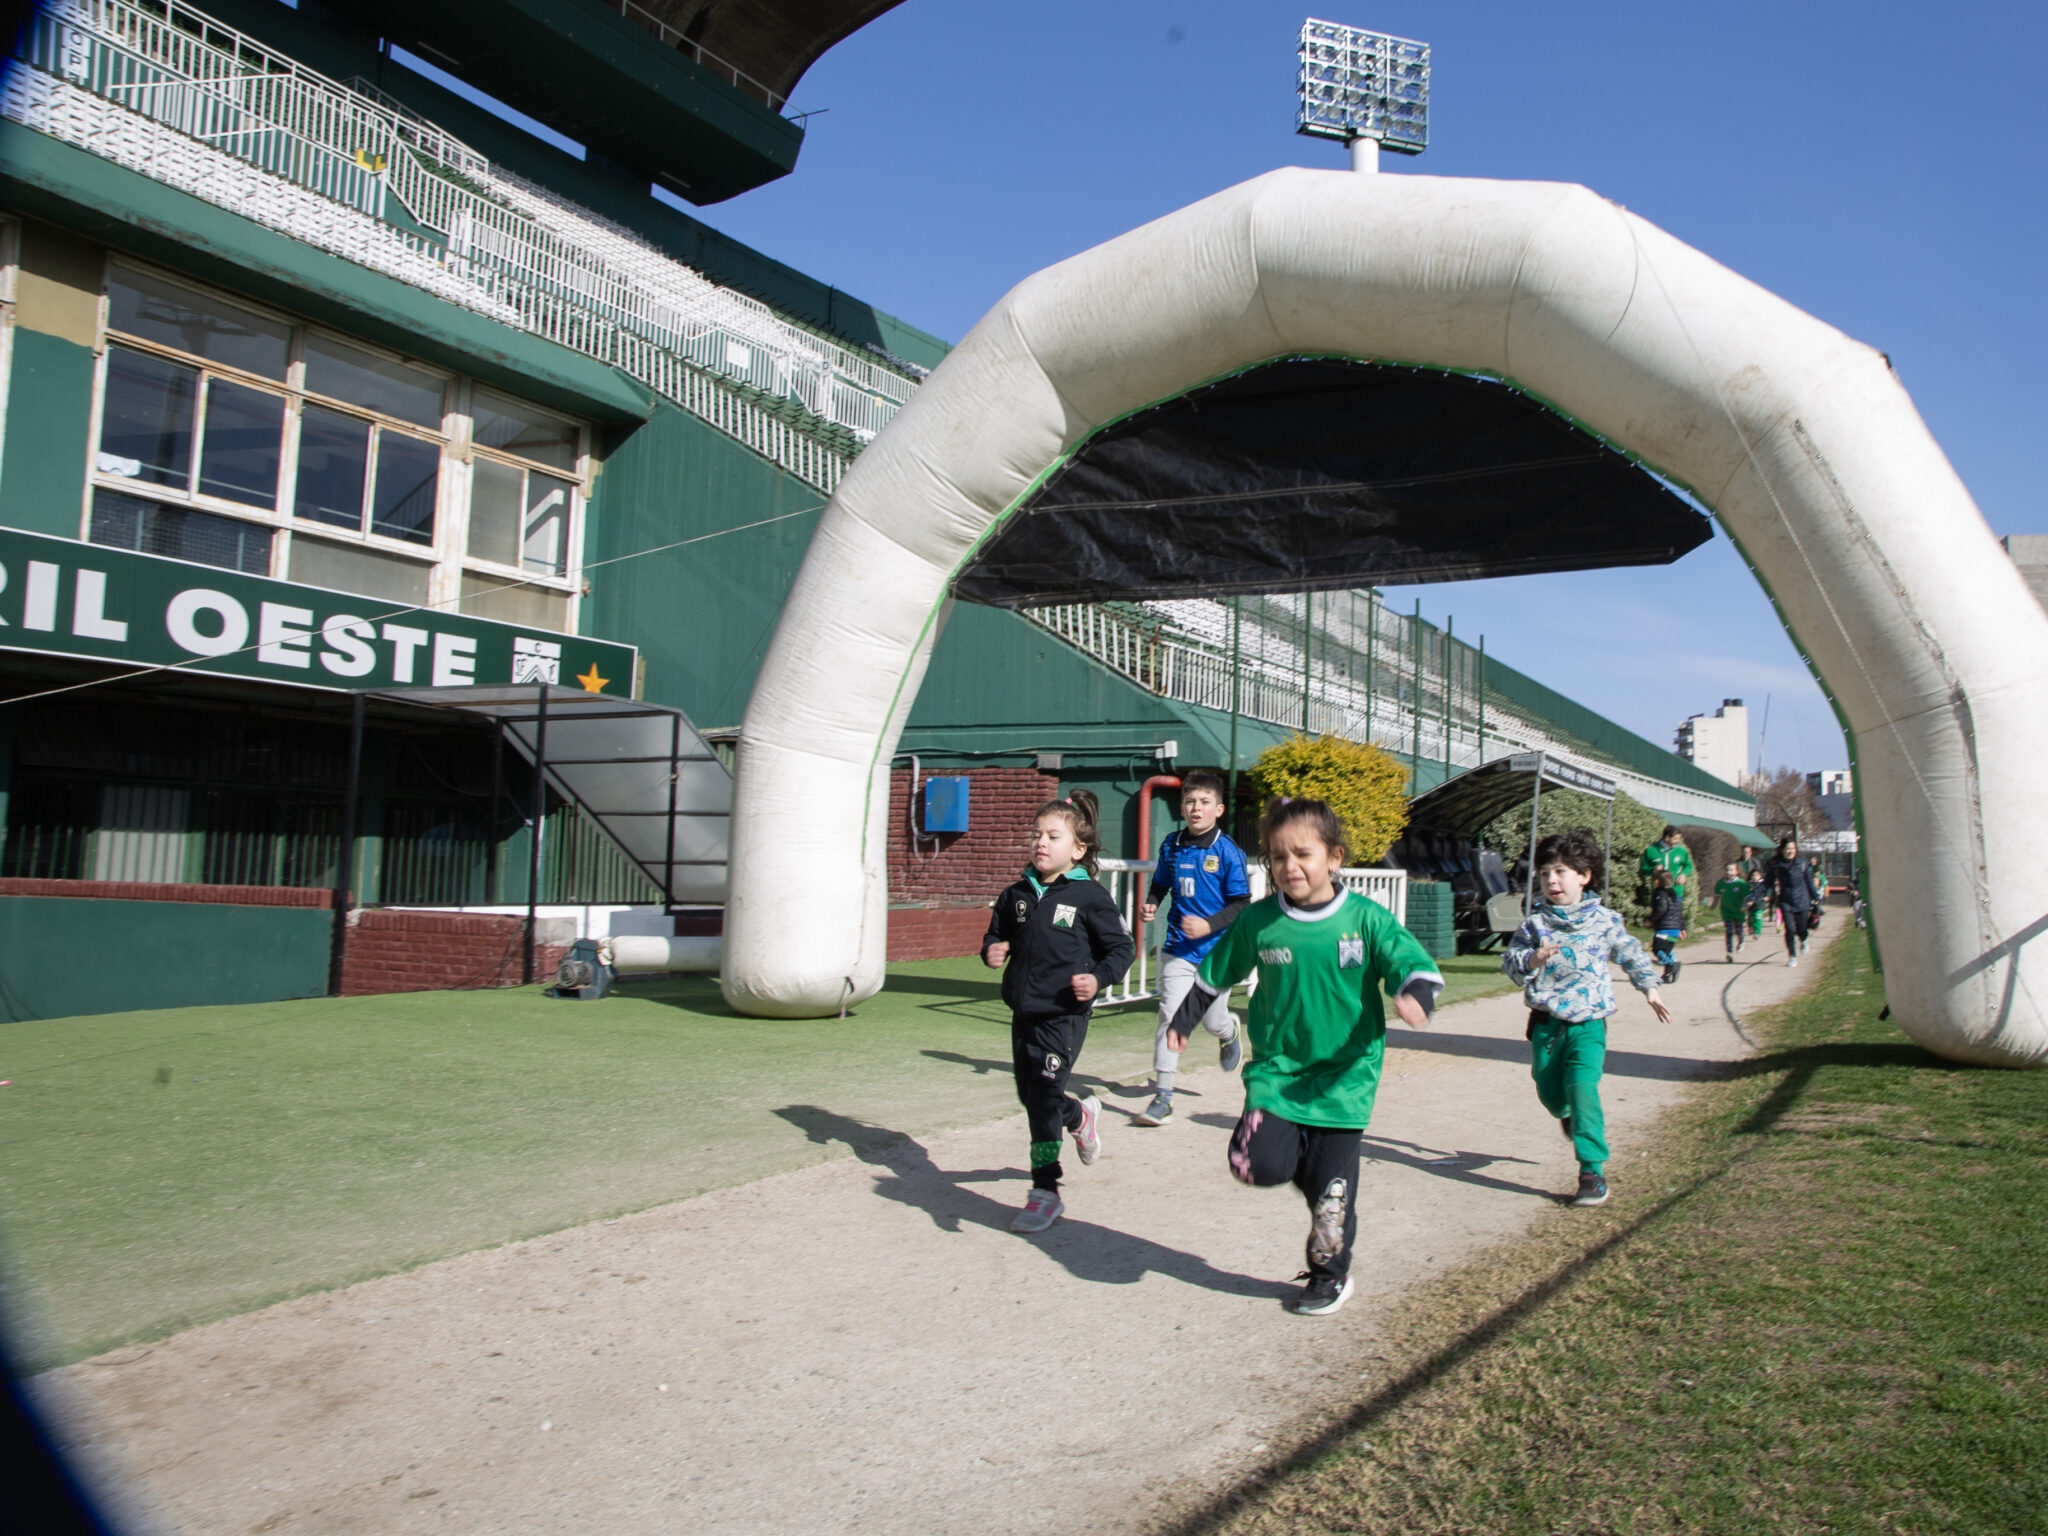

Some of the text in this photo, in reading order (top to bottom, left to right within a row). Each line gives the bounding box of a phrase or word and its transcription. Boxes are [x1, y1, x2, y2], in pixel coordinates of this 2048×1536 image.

[0, 560, 477, 687] IL OESTE
[1179, 877, 1195, 897] 10
